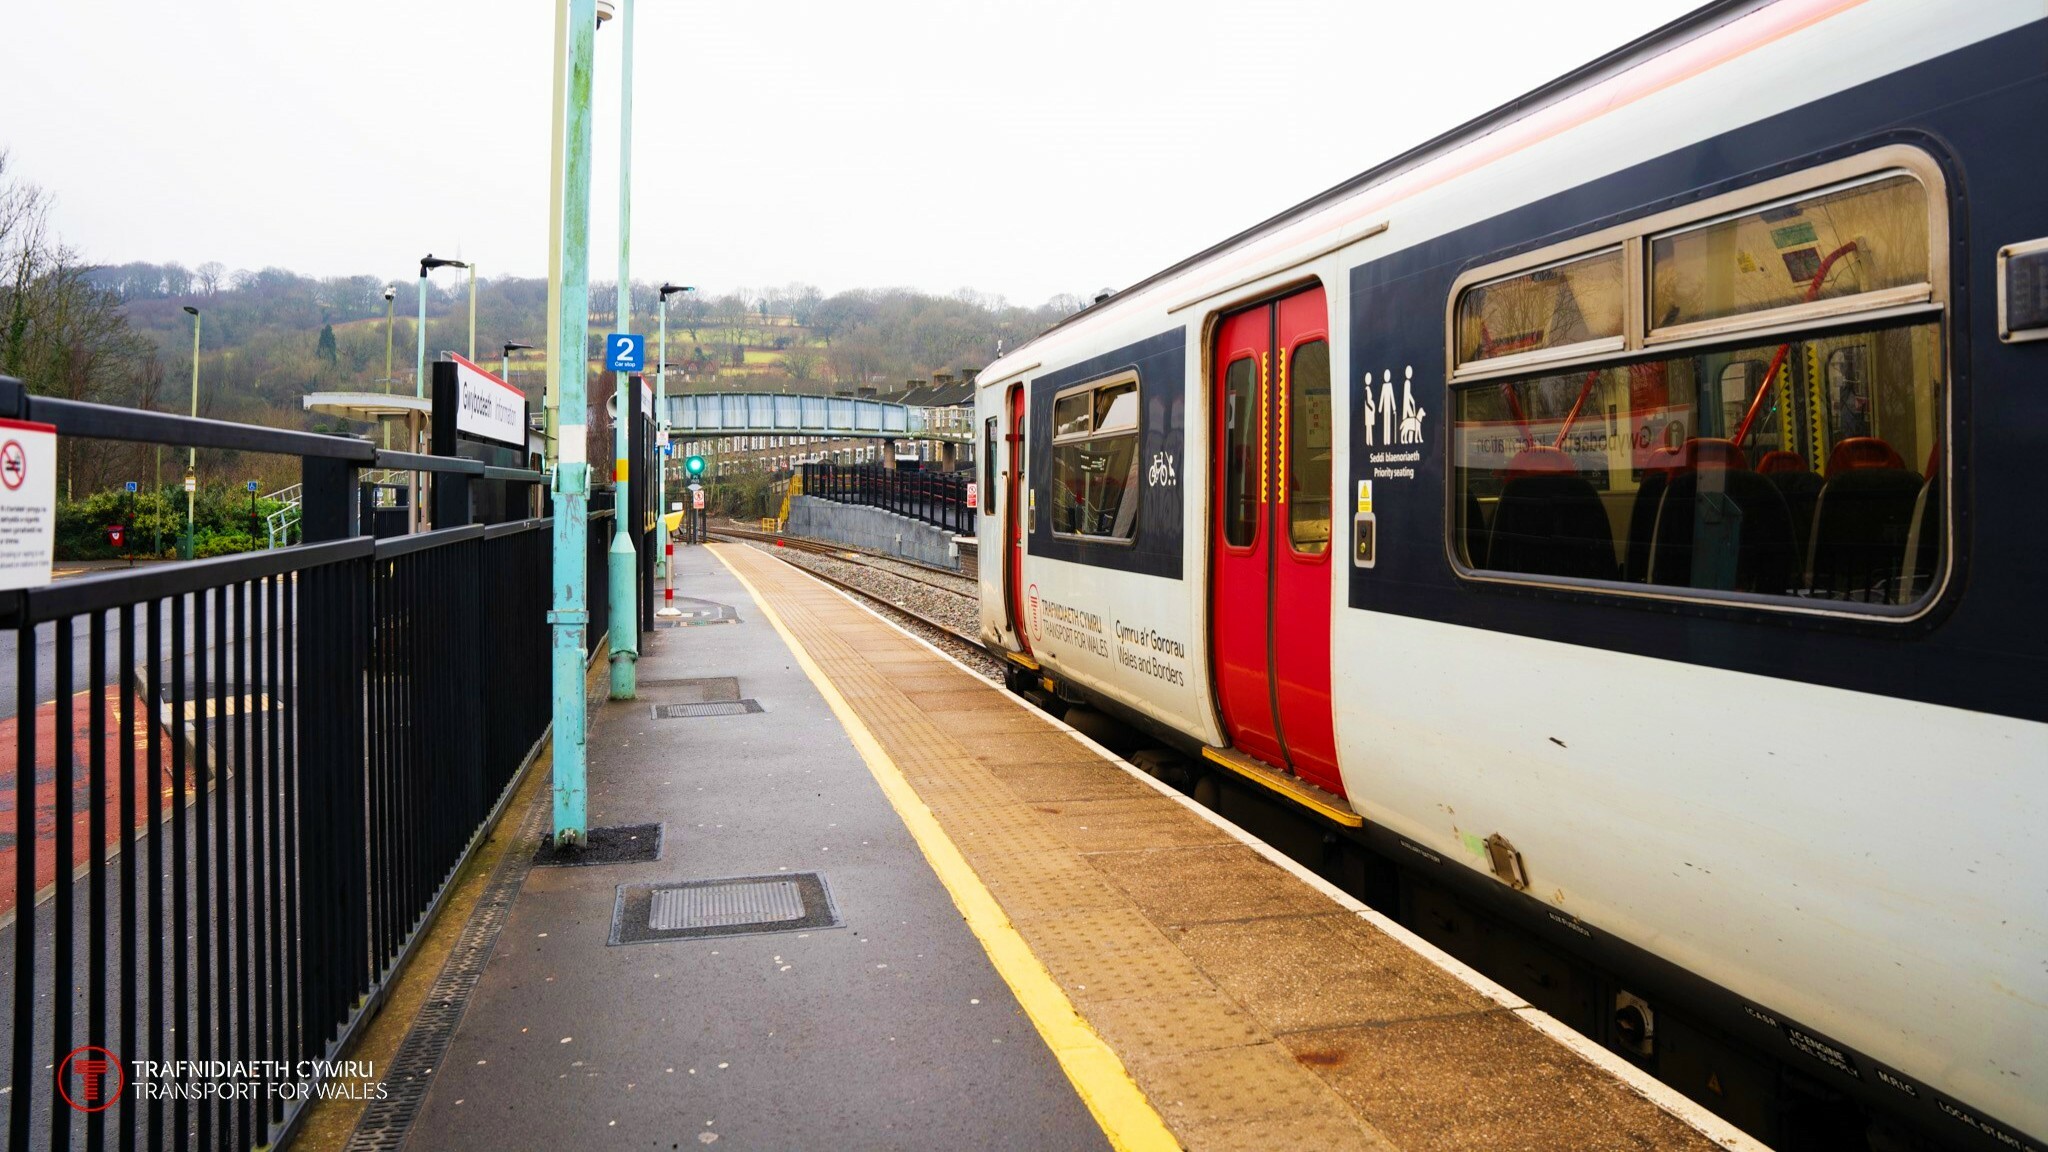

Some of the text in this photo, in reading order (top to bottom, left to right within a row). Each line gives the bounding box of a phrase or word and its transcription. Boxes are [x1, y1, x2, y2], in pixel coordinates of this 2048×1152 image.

[617, 338, 634, 361] 2
[463, 381, 492, 420] Gwybodaeth
[1370, 450, 1420, 463] Seddi blaenoriaeth
[1374, 466, 1415, 479] Priority seating
[1042, 599, 1102, 633] TRAFNIDIAETH CYMRU
[1043, 619, 1109, 658] TRANSPORT FOR WALES
[1116, 620, 1185, 659] Cymru a'r Gororau
[1117, 645, 1184, 687] Wales and Borders
